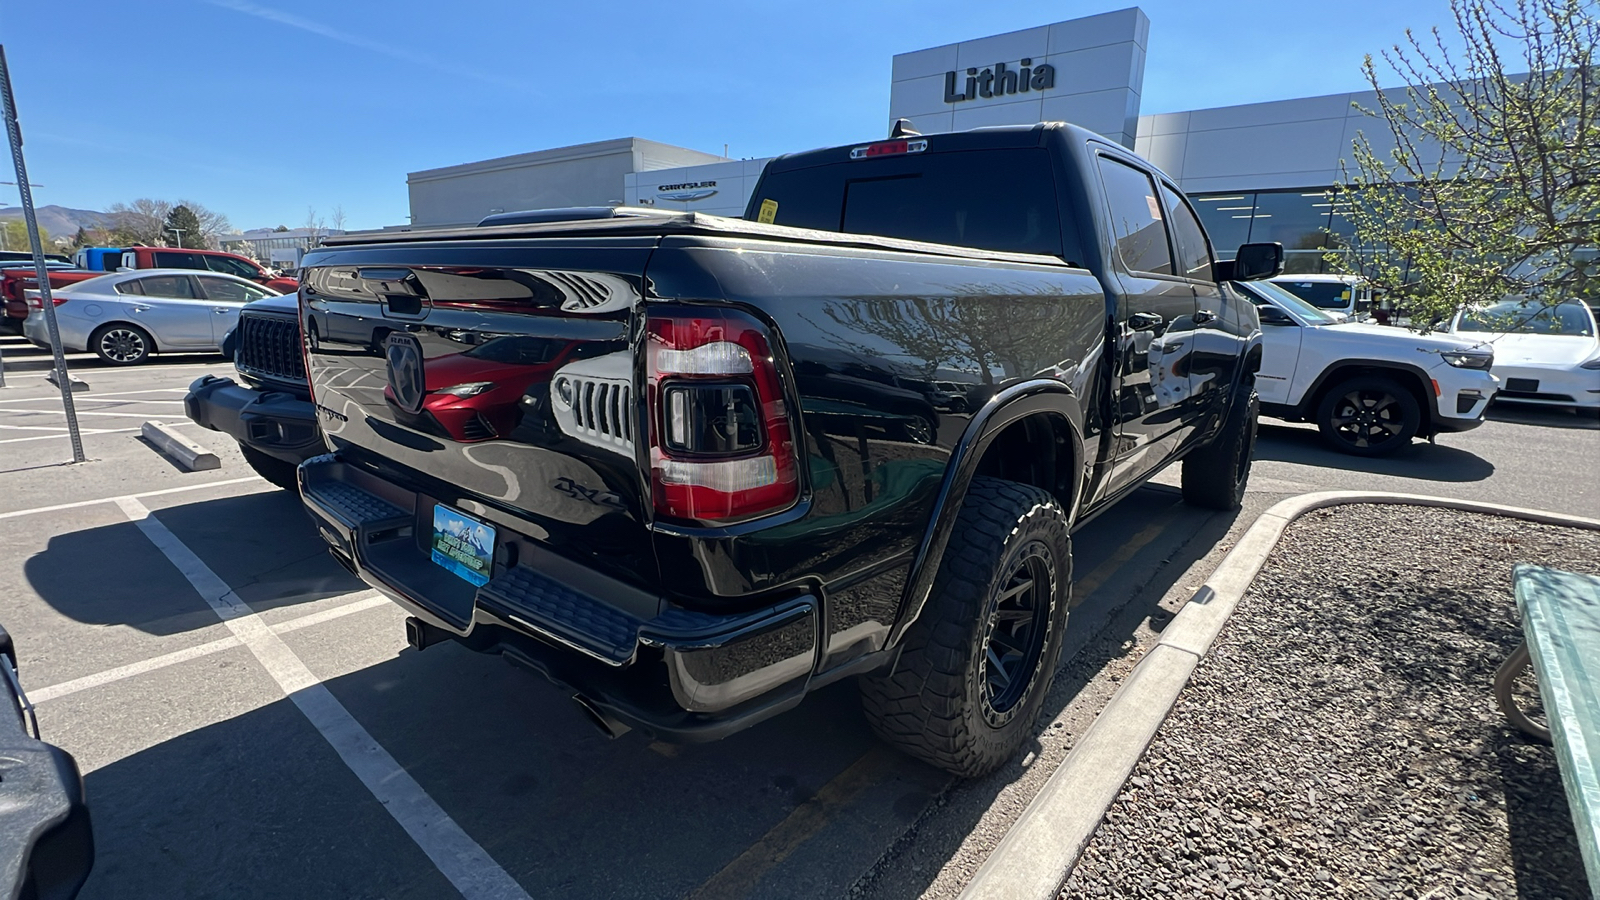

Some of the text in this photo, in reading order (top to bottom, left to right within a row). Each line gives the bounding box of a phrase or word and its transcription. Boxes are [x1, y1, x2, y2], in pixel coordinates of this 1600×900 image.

[944, 58, 1055, 103] Lithia
[658, 181, 717, 192] CHRYSLER
[390, 337, 411, 345] RAM
